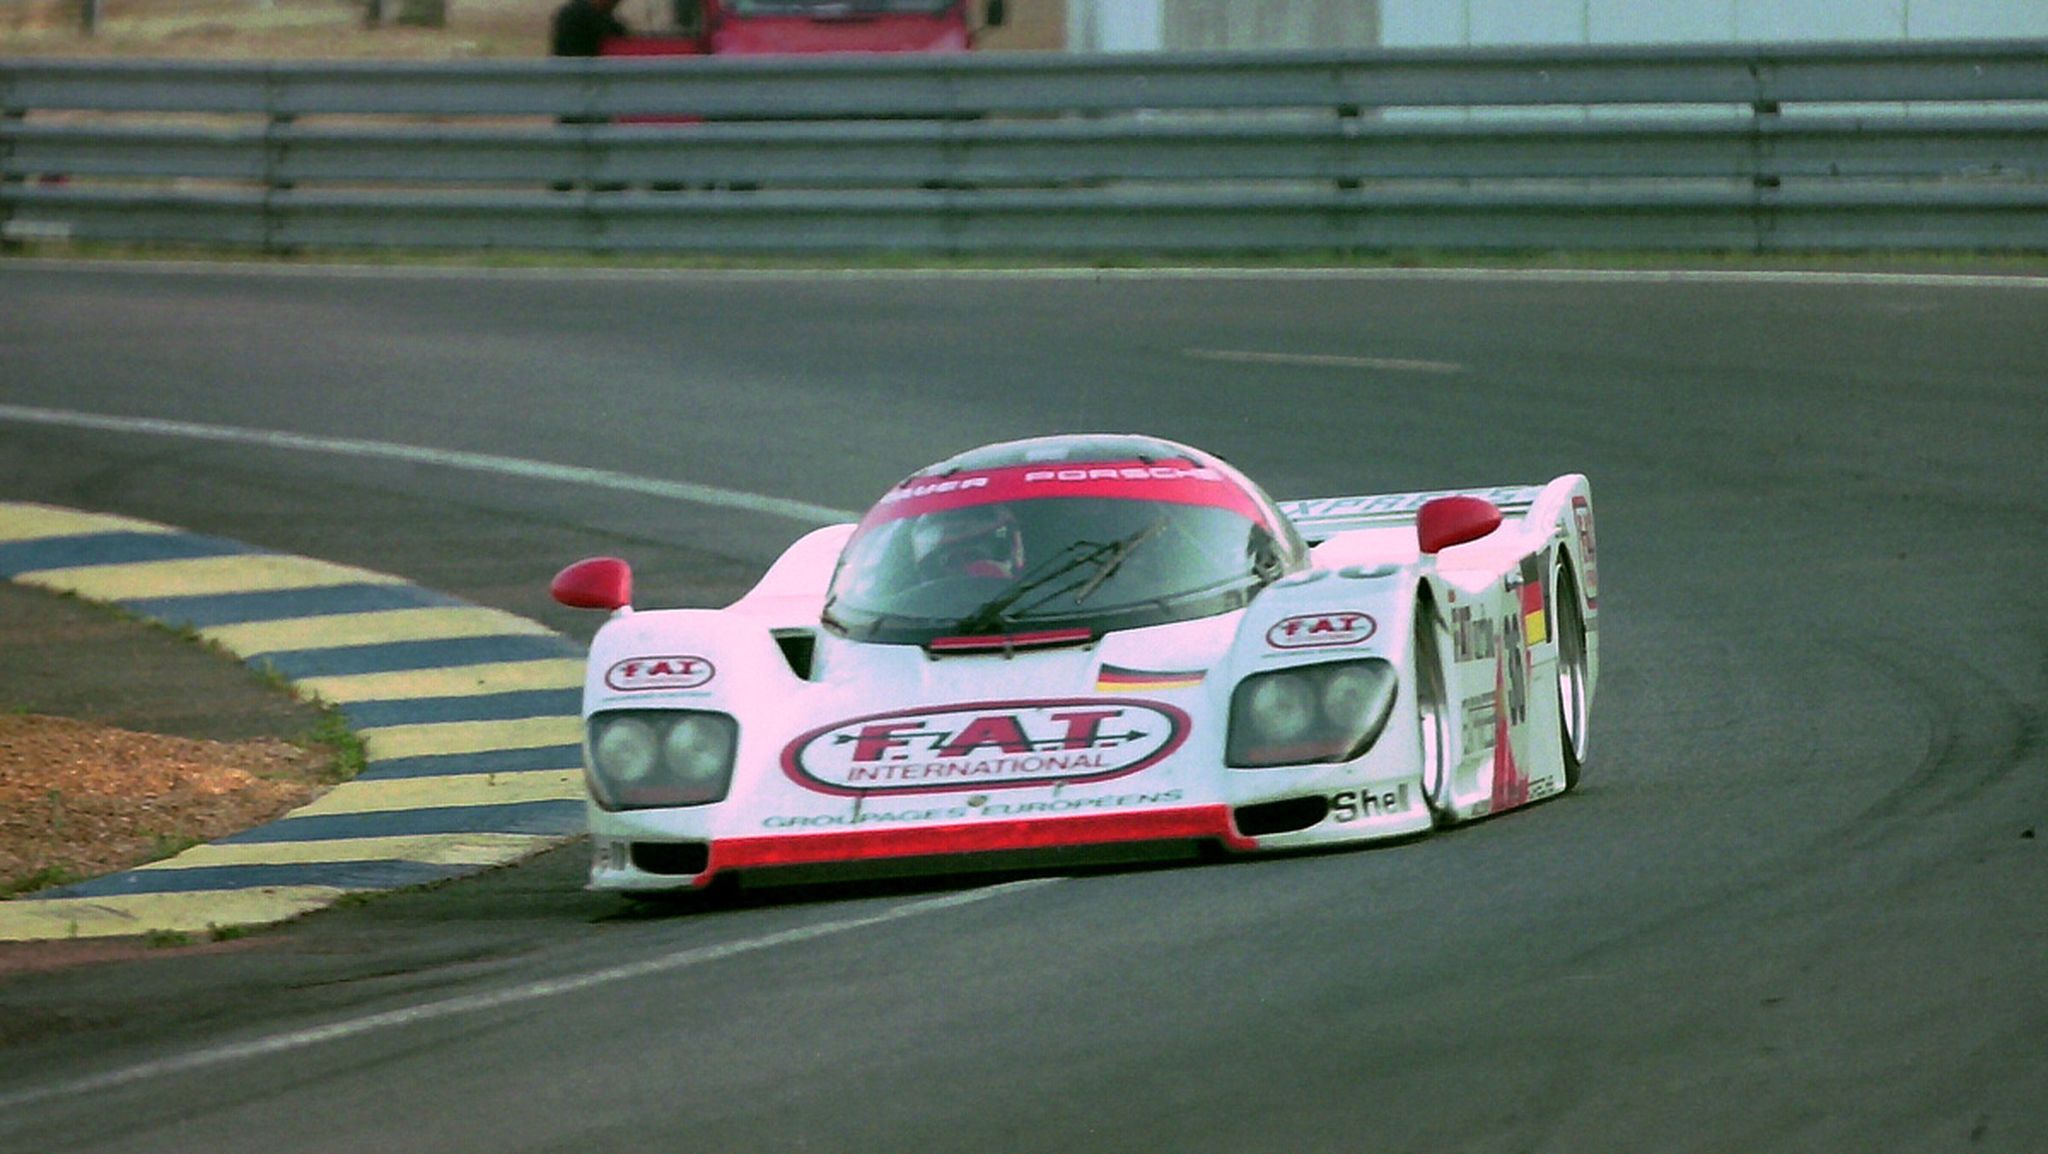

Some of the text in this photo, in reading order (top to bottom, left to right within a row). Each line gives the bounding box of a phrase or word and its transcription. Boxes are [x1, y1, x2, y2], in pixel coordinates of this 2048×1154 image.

[847, 752, 1106, 782] INTERNATIONAL
[763, 807, 967, 827] GROUPAGES
[1334, 783, 1410, 823] Shell
